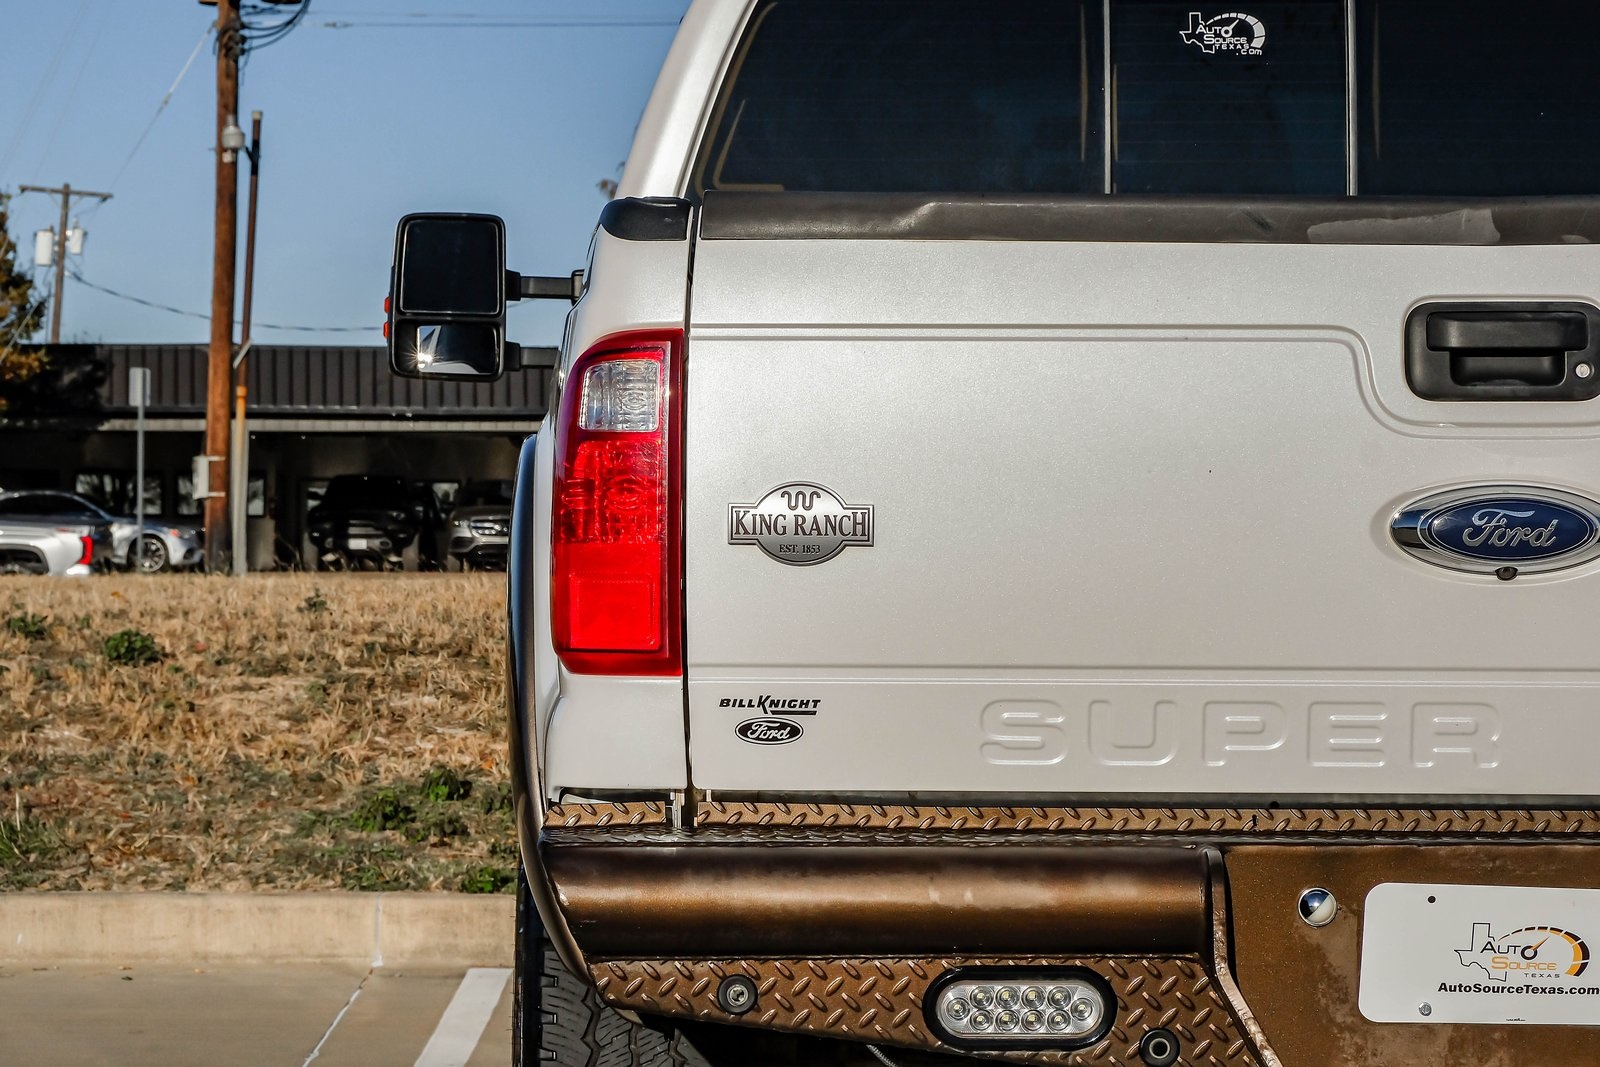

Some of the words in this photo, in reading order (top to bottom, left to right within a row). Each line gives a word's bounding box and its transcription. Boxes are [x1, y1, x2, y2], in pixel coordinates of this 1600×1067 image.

[734, 510, 788, 536] KING
[793, 511, 868, 537] RANCH
[1462, 508, 1559, 547] Ford
[779, 544, 799, 554] EST.
[802, 544, 821, 554] 1853
[747, 721, 792, 739] Ford
[979, 699, 1501, 769] SUPER
[1438, 983, 1600, 995] AutoSourceTexas.com
